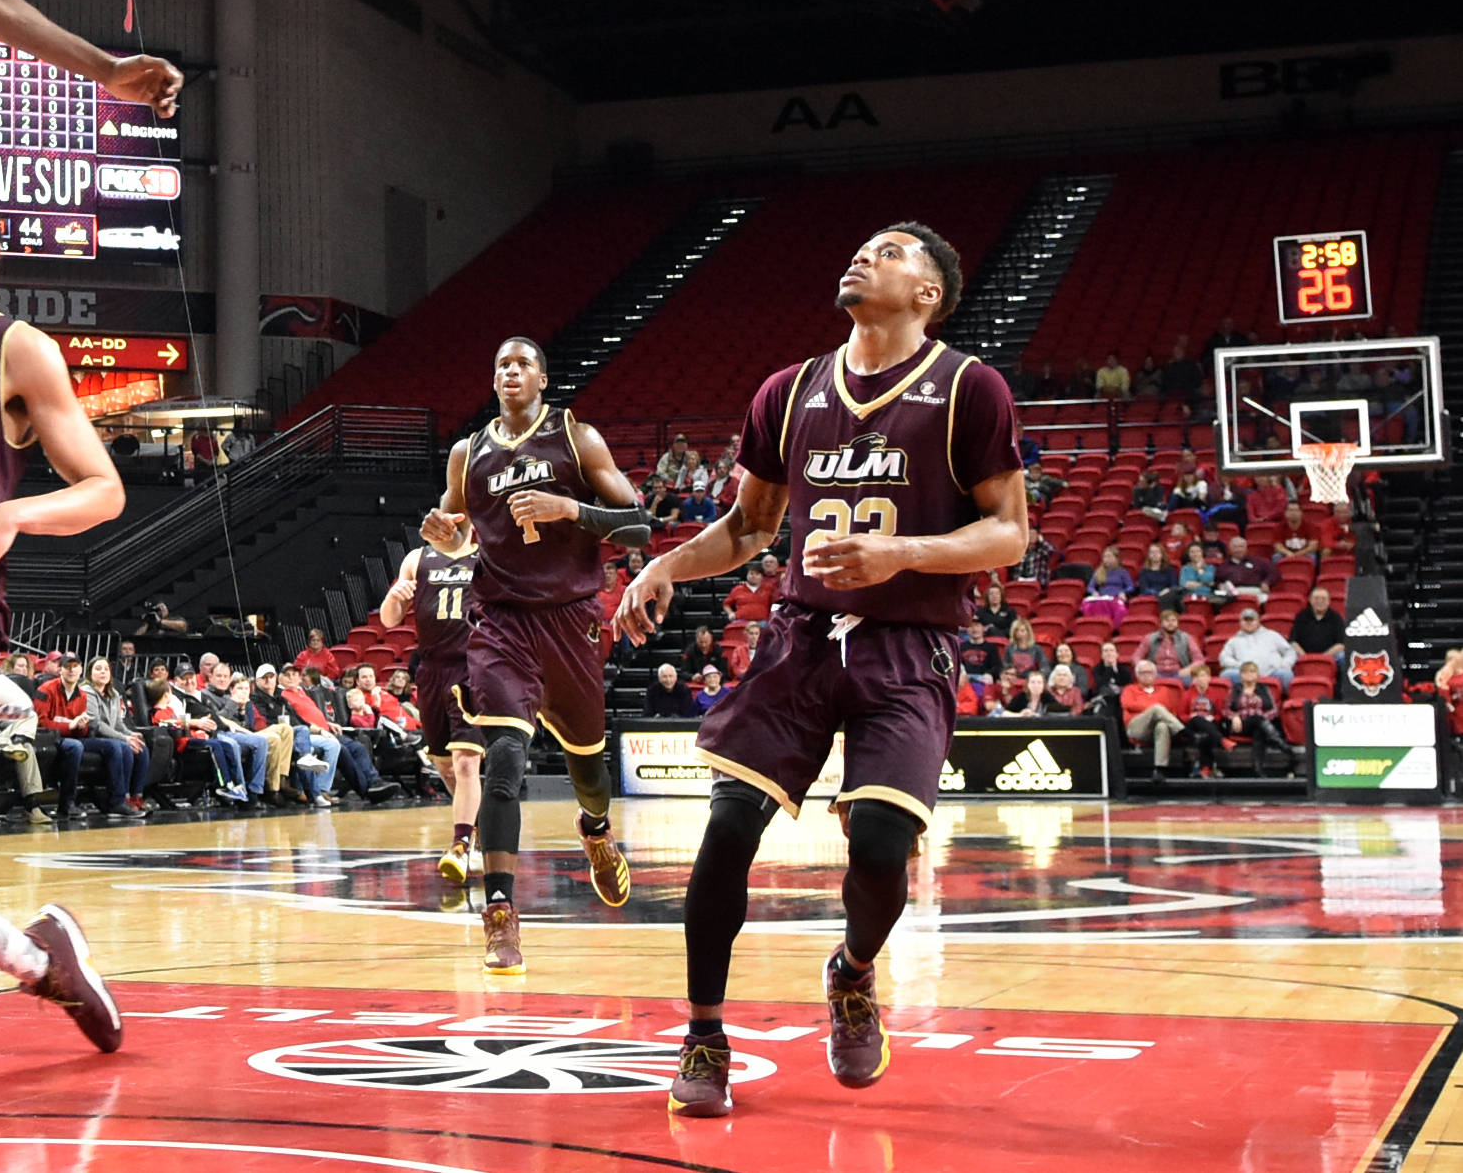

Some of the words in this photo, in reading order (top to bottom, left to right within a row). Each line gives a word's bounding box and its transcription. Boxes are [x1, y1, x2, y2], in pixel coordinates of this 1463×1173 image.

[48, 65, 57, 79] 0
[21, 82, 30, 95] 0
[48, 83, 57, 96] 0
[76, 85, 84, 99] 1
[21, 98, 31, 113] 2
[48, 100, 57, 114] 0
[76, 102, 85, 116] 2
[770, 93, 879, 134] AA
[21, 115, 31, 130] 2
[48, 117, 57, 131] 3
[75, 119, 85, 133] 3
[20, 132, 30, 146] 4
[48, 133, 57, 147] 3
[77, 135, 84, 149] 1
[18, 217, 42, 237] 44
[1300, 241, 1357, 269] 2:58
[1298, 267, 1353, 313] 26
[69, 337, 127, 351] AA-DD
[80, 354, 116, 367] A-D
[437, 587, 463, 620] 11
[629, 738, 654, 756] WE
[1322, 759, 1393, 775] SUBWAY
[995, 770, 1073, 791] adidas
[121, 1006, 624, 1035] BELT
